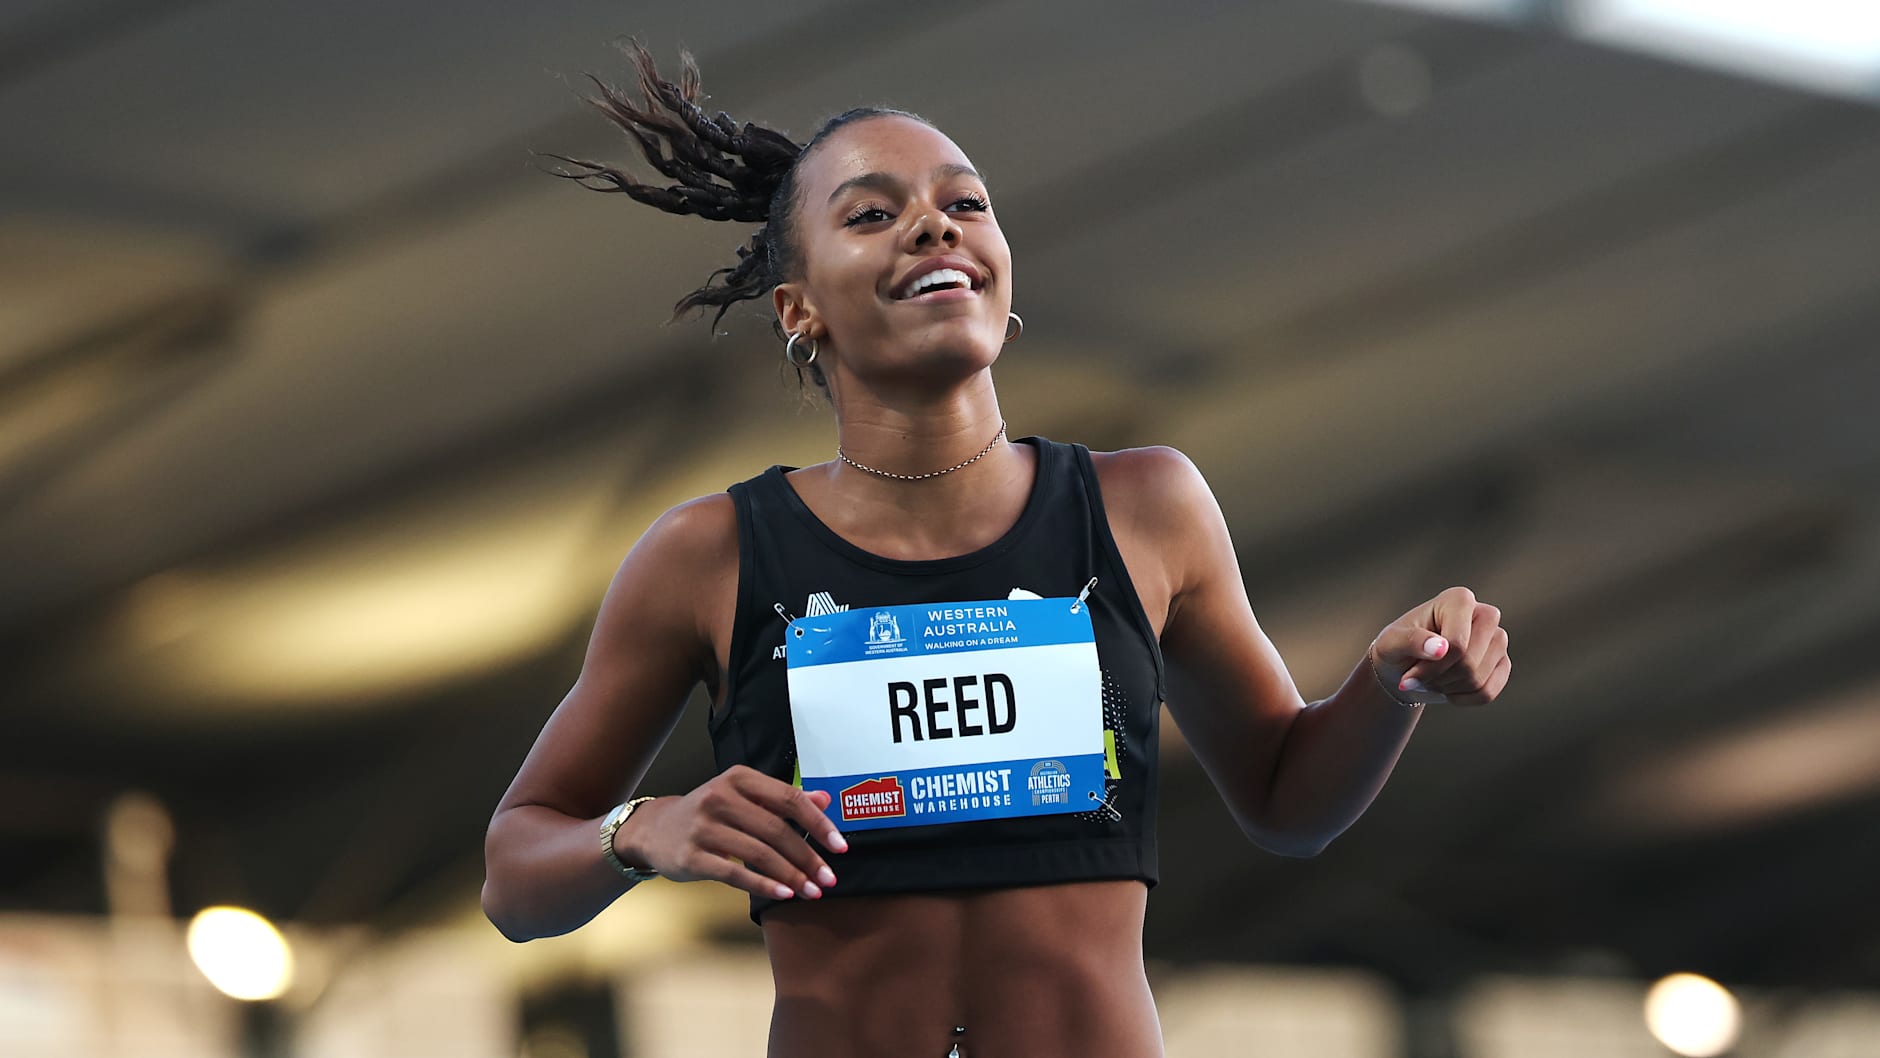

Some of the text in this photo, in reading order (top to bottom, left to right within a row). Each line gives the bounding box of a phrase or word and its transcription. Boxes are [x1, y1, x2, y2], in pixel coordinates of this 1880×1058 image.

[928, 606, 1008, 622] WESTERN
[923, 620, 1017, 638] AUSTRALIA
[925, 641, 965, 650] WALKING
[966, 639, 979, 647] ON
[987, 636, 1018, 645] DREAM
[888, 673, 1016, 743] REED
[911, 769, 1011, 800] CHEMIST
[1027, 773, 1071, 791] ATHLETICS
[845, 791, 900, 807] CHEMIST
[913, 794, 1011, 814] WAREHOUSE
[1041, 793, 1060, 804] PERTH
[846, 805, 900, 815] WAREHOUSE
